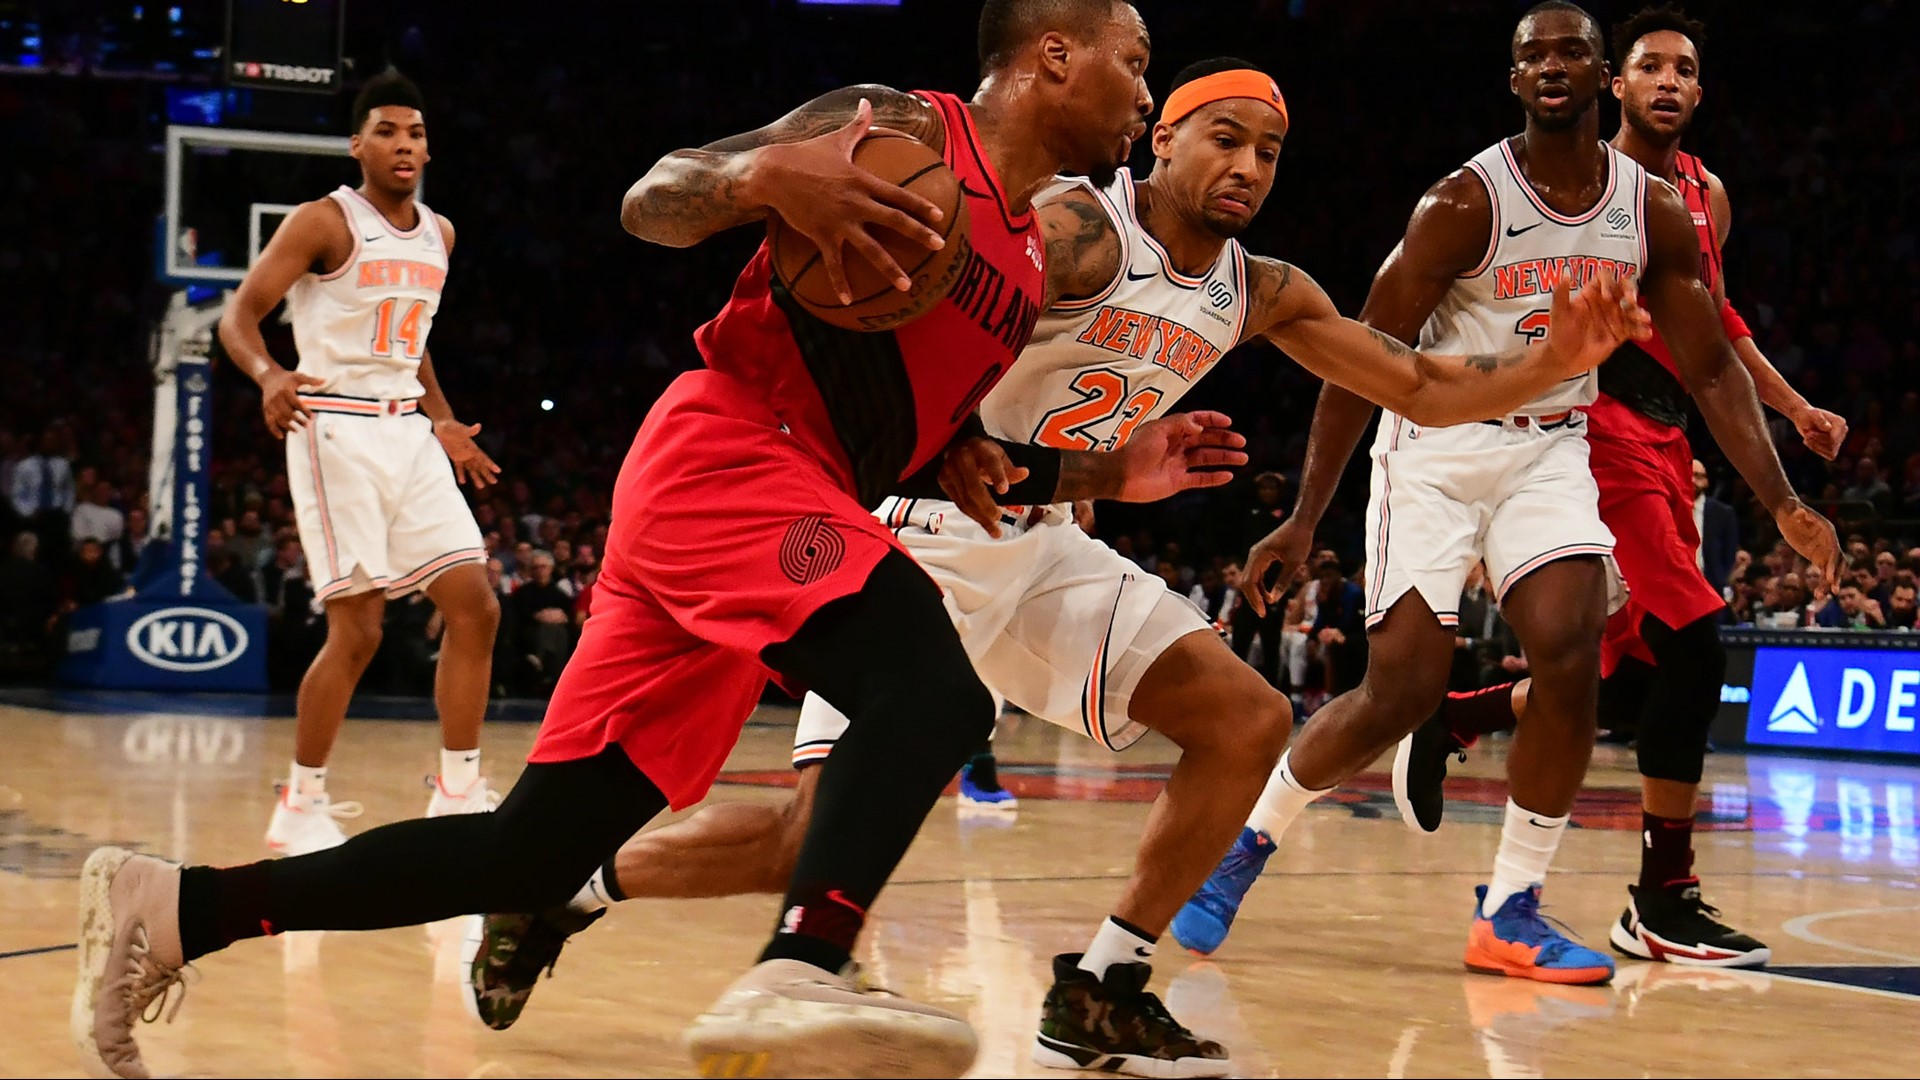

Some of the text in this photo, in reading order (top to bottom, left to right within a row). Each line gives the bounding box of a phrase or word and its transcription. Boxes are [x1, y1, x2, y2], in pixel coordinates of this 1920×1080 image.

[261, 63, 334, 83] TISSOT
[1494, 256, 1565, 299] NEW
[371, 297, 428, 360] 14
[1076, 305, 1221, 382] NEW YORK
[1030, 367, 1164, 451] 23
[150, 621, 228, 657] KIA
[1836, 667, 1920, 732] DE
